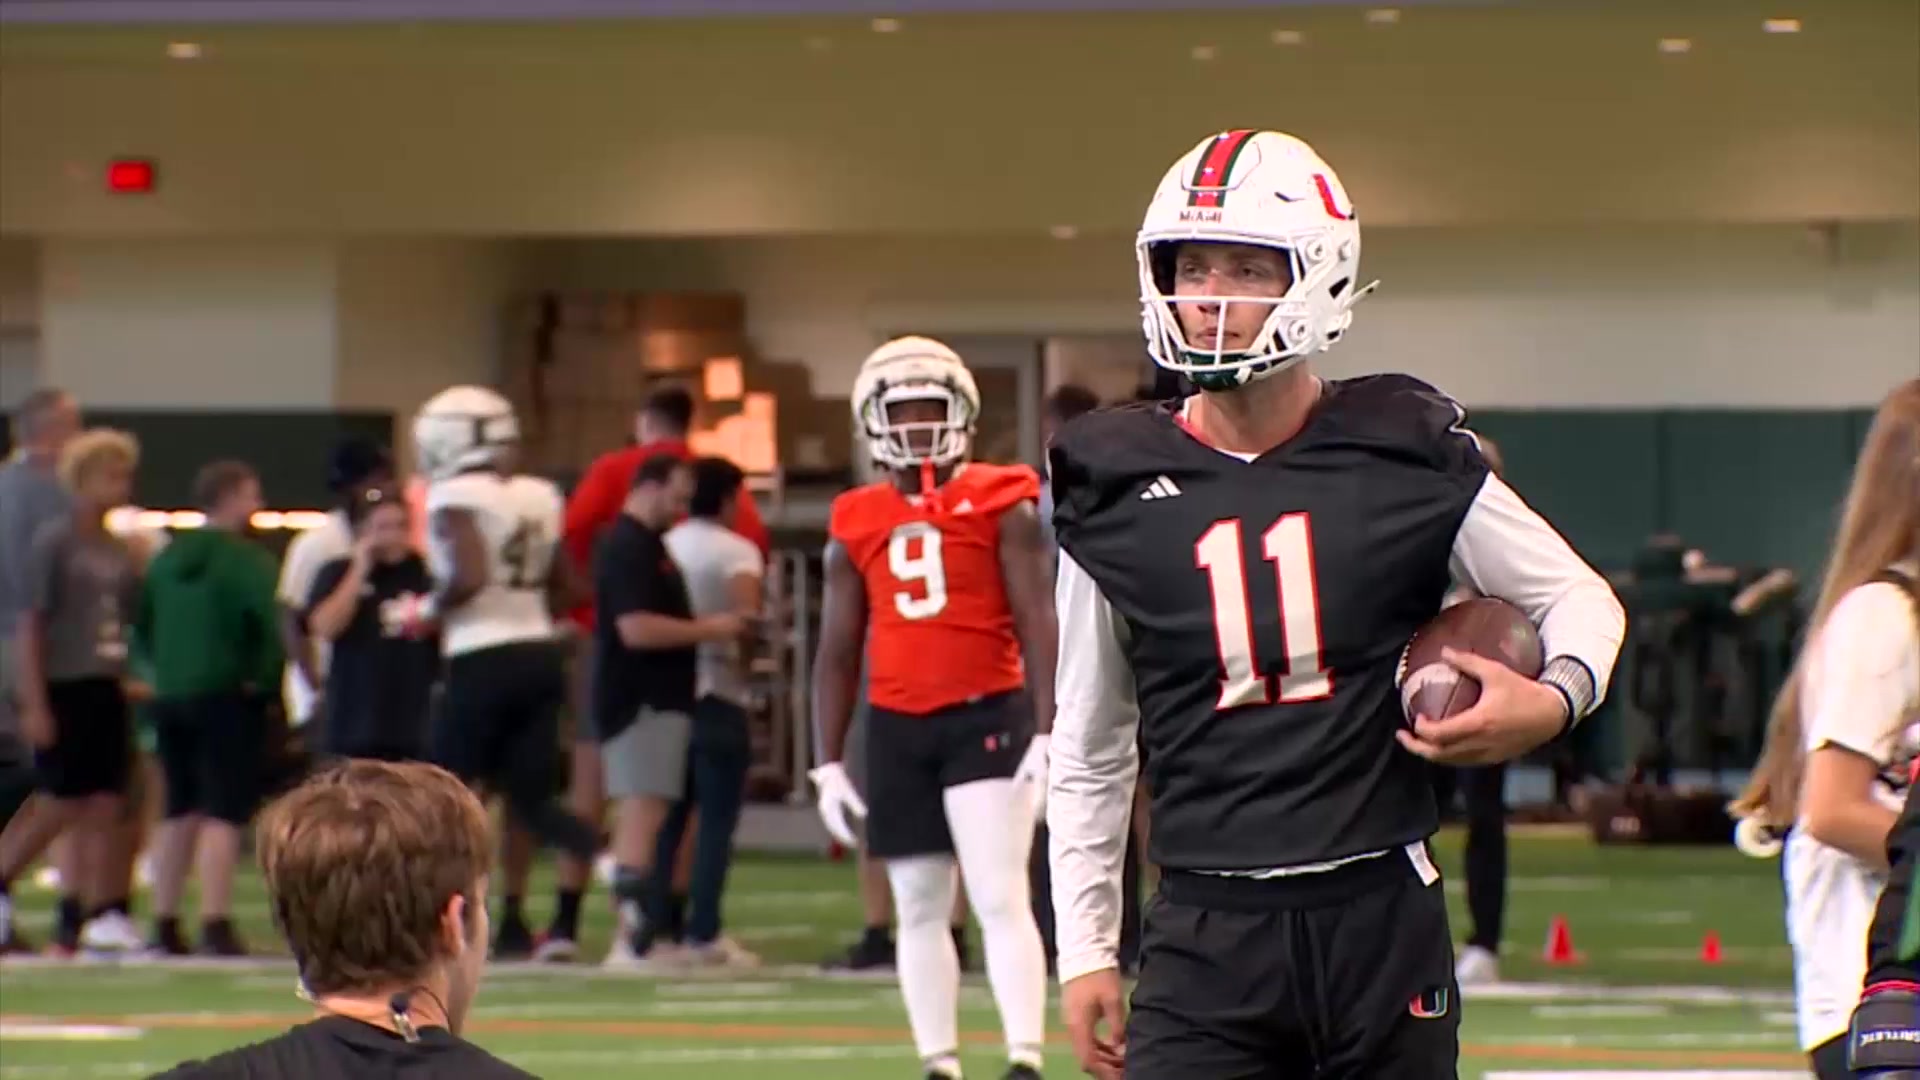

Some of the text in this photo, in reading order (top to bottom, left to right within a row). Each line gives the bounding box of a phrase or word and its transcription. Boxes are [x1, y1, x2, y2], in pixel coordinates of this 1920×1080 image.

[888, 520, 948, 620] 9
[1194, 511, 1335, 712] 11
[1408, 987, 1448, 1018] U
